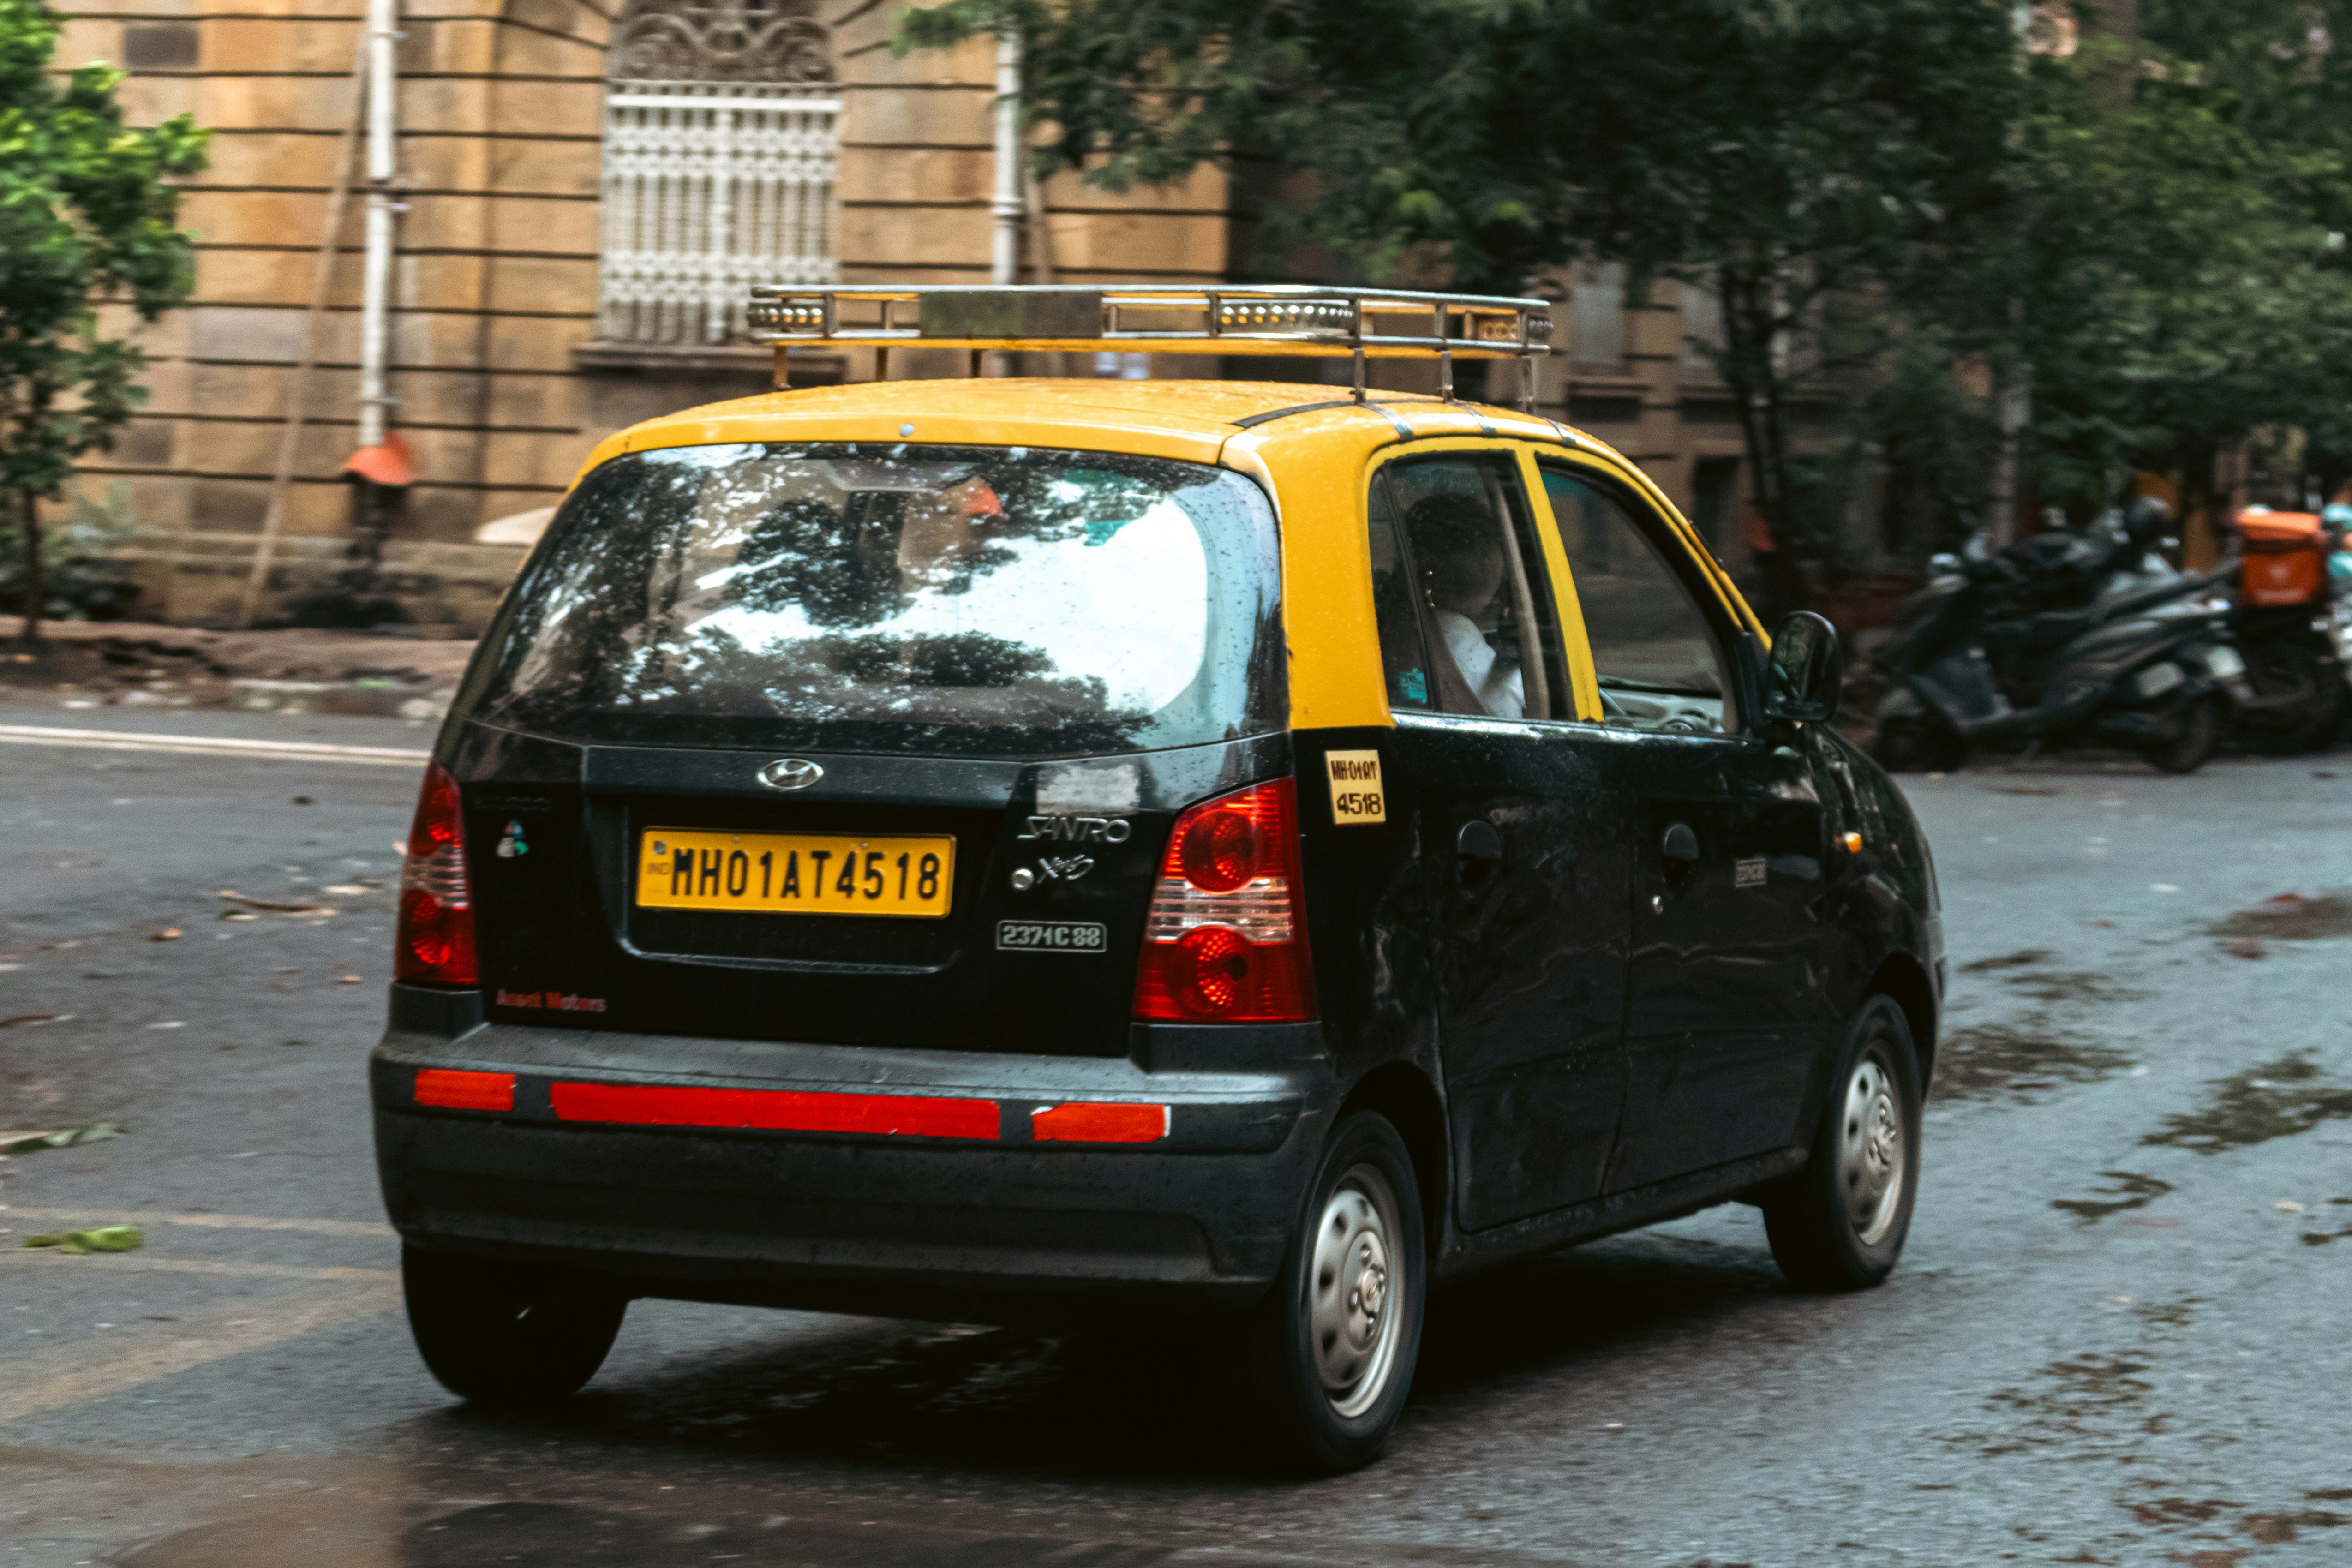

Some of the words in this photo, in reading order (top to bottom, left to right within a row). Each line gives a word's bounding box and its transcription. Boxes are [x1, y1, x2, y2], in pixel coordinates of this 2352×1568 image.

[1336, 793, 1382, 814] 4518
[1016, 816, 1131, 843] SANTRO
[670, 848, 940, 900] MH01AT4518
[546, 991, 607, 1012] Motors
